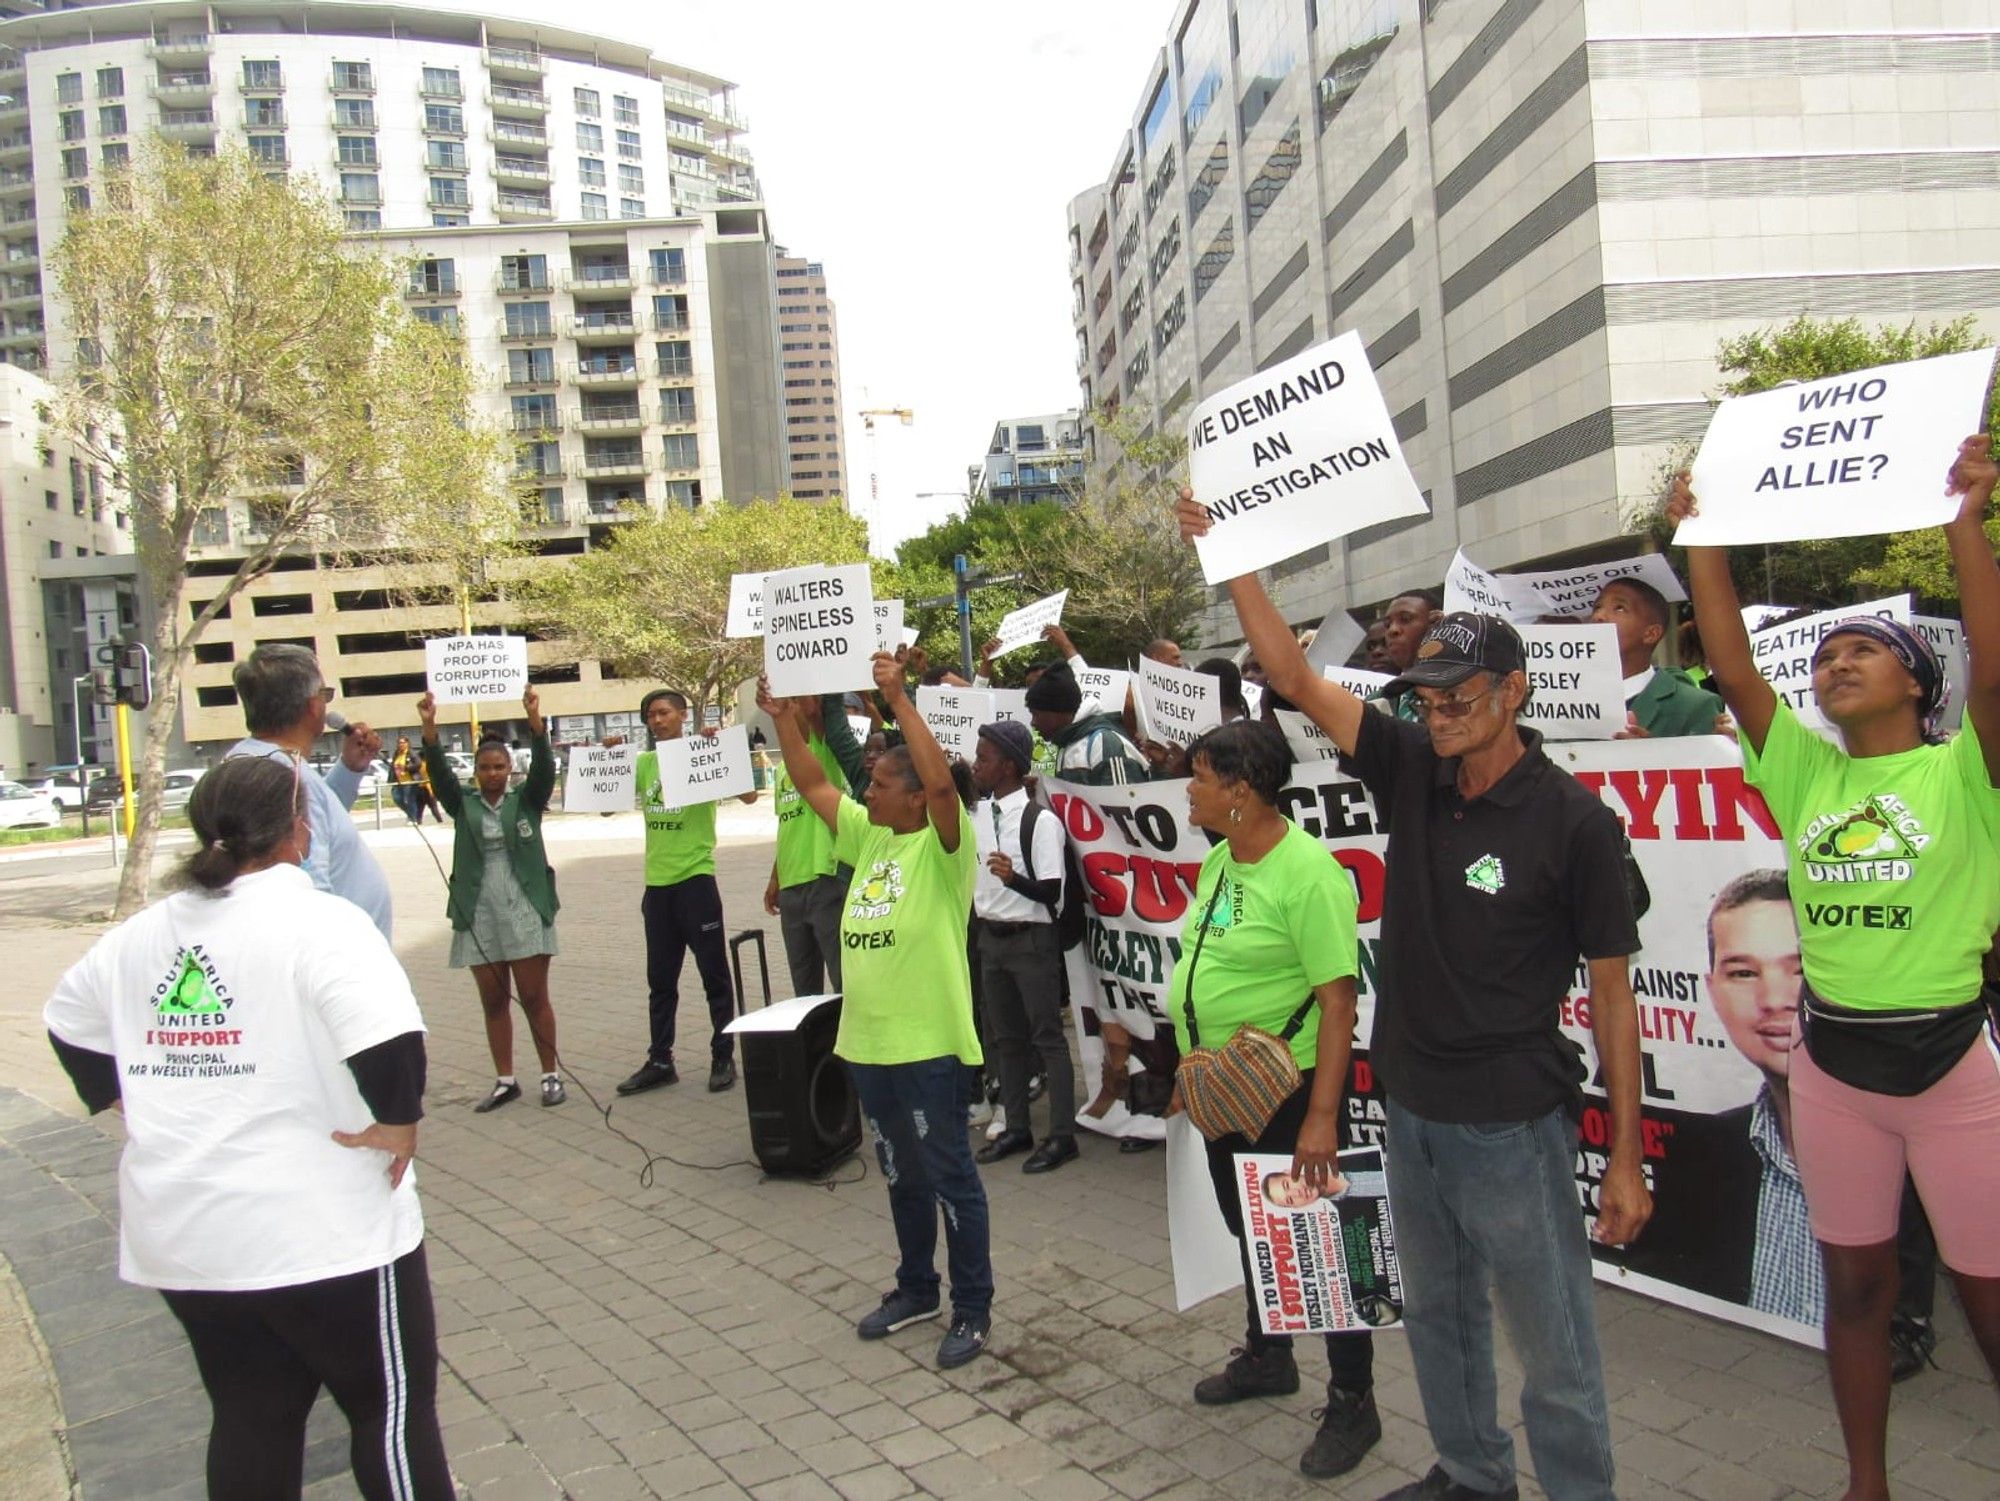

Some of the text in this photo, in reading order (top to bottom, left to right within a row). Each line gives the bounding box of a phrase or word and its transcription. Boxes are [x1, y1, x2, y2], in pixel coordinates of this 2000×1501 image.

[1192, 361, 1345, 451] WE DEMAND
[1798, 378, 1887, 412] WHO
[1780, 415, 1883, 449] SENT
[1252, 432, 1293, 468] AN
[1206, 438, 1391, 525] NVESTIGATION
[1755, 454, 1889, 492] ALLIE?
[1463, 567, 1486, 588] THE
[1604, 564, 1643, 578] OFF
[775, 578, 844, 605] WALTERS
[771, 607, 854, 634] SPINELESS
[447, 640, 504, 651] NPA HAS
[776, 637, 848, 661] COWARD
[1525, 641, 1596, 659] NDS OFF
[443, 654, 509, 667] PROOF OF
[435, 668, 520, 682] CORRUPTION
[1079, 673, 1111, 686] TERS
[1529, 672, 1580, 690] ESLEY
[451, 683, 506, 695] IN WCED
[1183, 683, 1206, 700] OFF
[939, 696, 959, 709] THE
[1155, 699, 1196, 721] WESLEY
[1521, 702, 1600, 720] UMANN
[928, 713, 974, 728] CORRUPT
[689, 738, 719, 751] WHO
[935, 733, 961, 745] RULE
[588, 751, 606, 762] WIE
[691, 752, 722, 767] SENT
[579, 765, 632, 777] VIR WARDA
[688, 767, 730, 784] ALLIE?
[593, 782, 619, 793] NOU?
[1100, 804, 1178, 852] TO
[1873, 792, 1930, 851] AFRICA
[1805, 860, 1912, 882] UNITED
[1233, 884, 1243, 926] AFRICA
[150, 944, 235, 1010] SOUTH AFRICA
[1633, 966, 1699, 1003] AINST
[1101, 979, 1170, 1018] THE
[158, 1013, 226, 1027] UNITED
[146, 1030, 242, 1046] I SUPPORT
[166, 1053, 226, 1065] PRINCIPAL
[128, 1064, 256, 1077] MR WESLEY NEUMANN
[1329, 1211, 1339, 1224] OF
[1308, 1212, 1320, 1246] AGAINST
[1243, 1161, 1284, 1331] NO TO WCED BULLYING
[1331, 1225, 1346, 1273] DISMISSAL
[1369, 1226, 1386, 1276] PRINCIPAL
[1376, 1199, 1401, 1300] MR WESLEY NEUMANN
[1314, 1248, 1325, 1270] FIGHT
[1267, 1213, 1307, 1331] I SUPPORT
[1291, 1212, 1324, 1329] WESLEY NEUMANN
[1330, 1280, 1346, 1328] INJUSTICE
